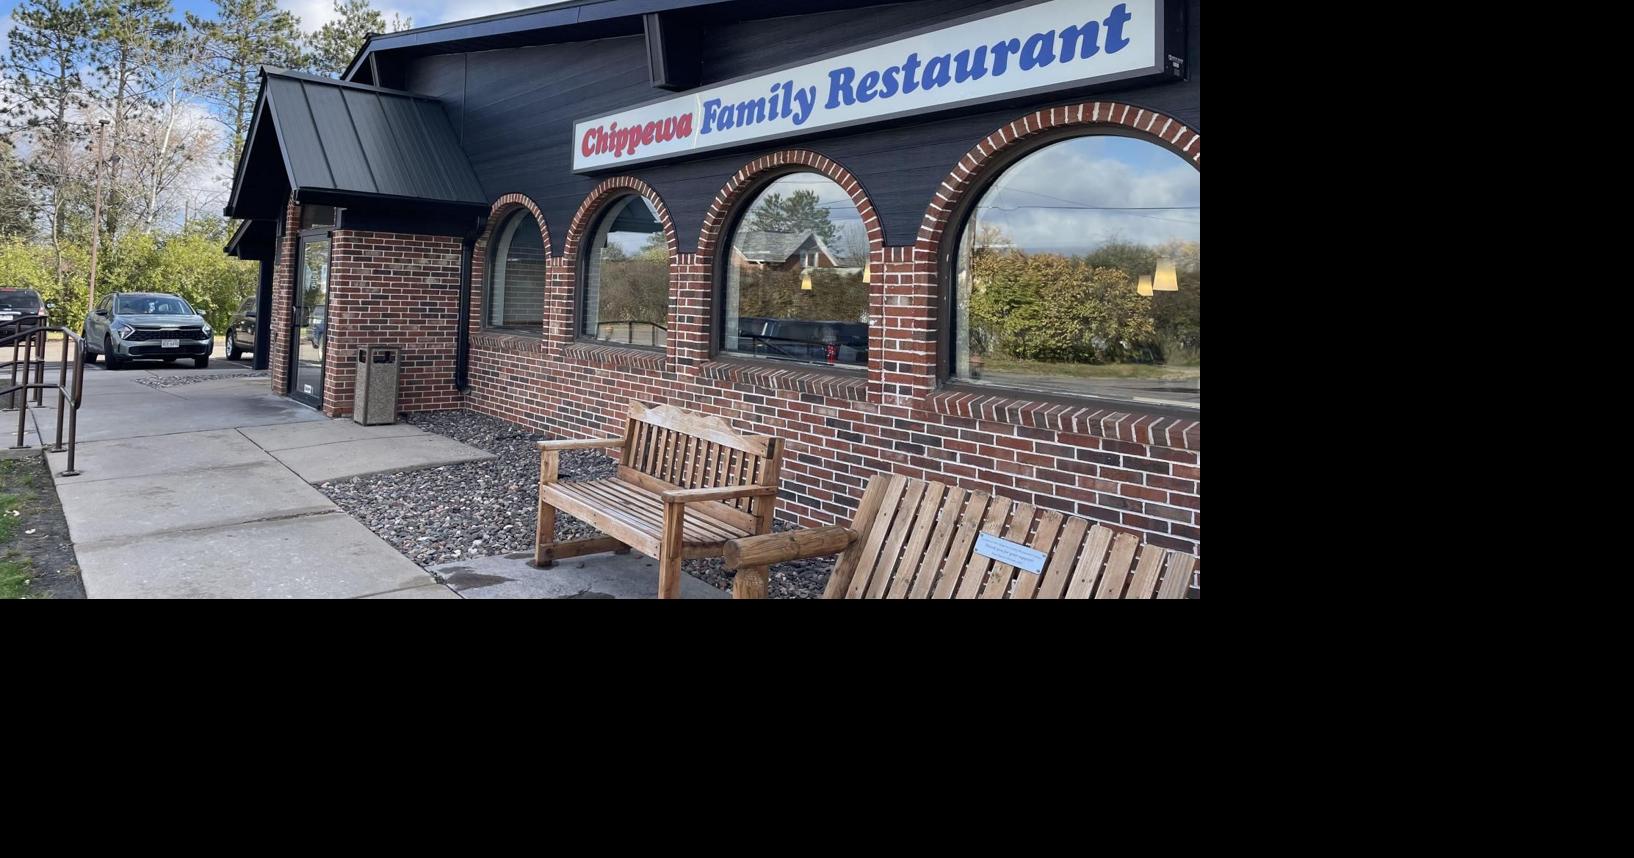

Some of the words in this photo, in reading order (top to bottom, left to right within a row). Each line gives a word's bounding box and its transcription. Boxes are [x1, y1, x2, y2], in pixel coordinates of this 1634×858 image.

[581, 112, 693, 157] Chippewa
[700, 80, 816, 135] Family
[825, 3, 1132, 110] Restaurant
